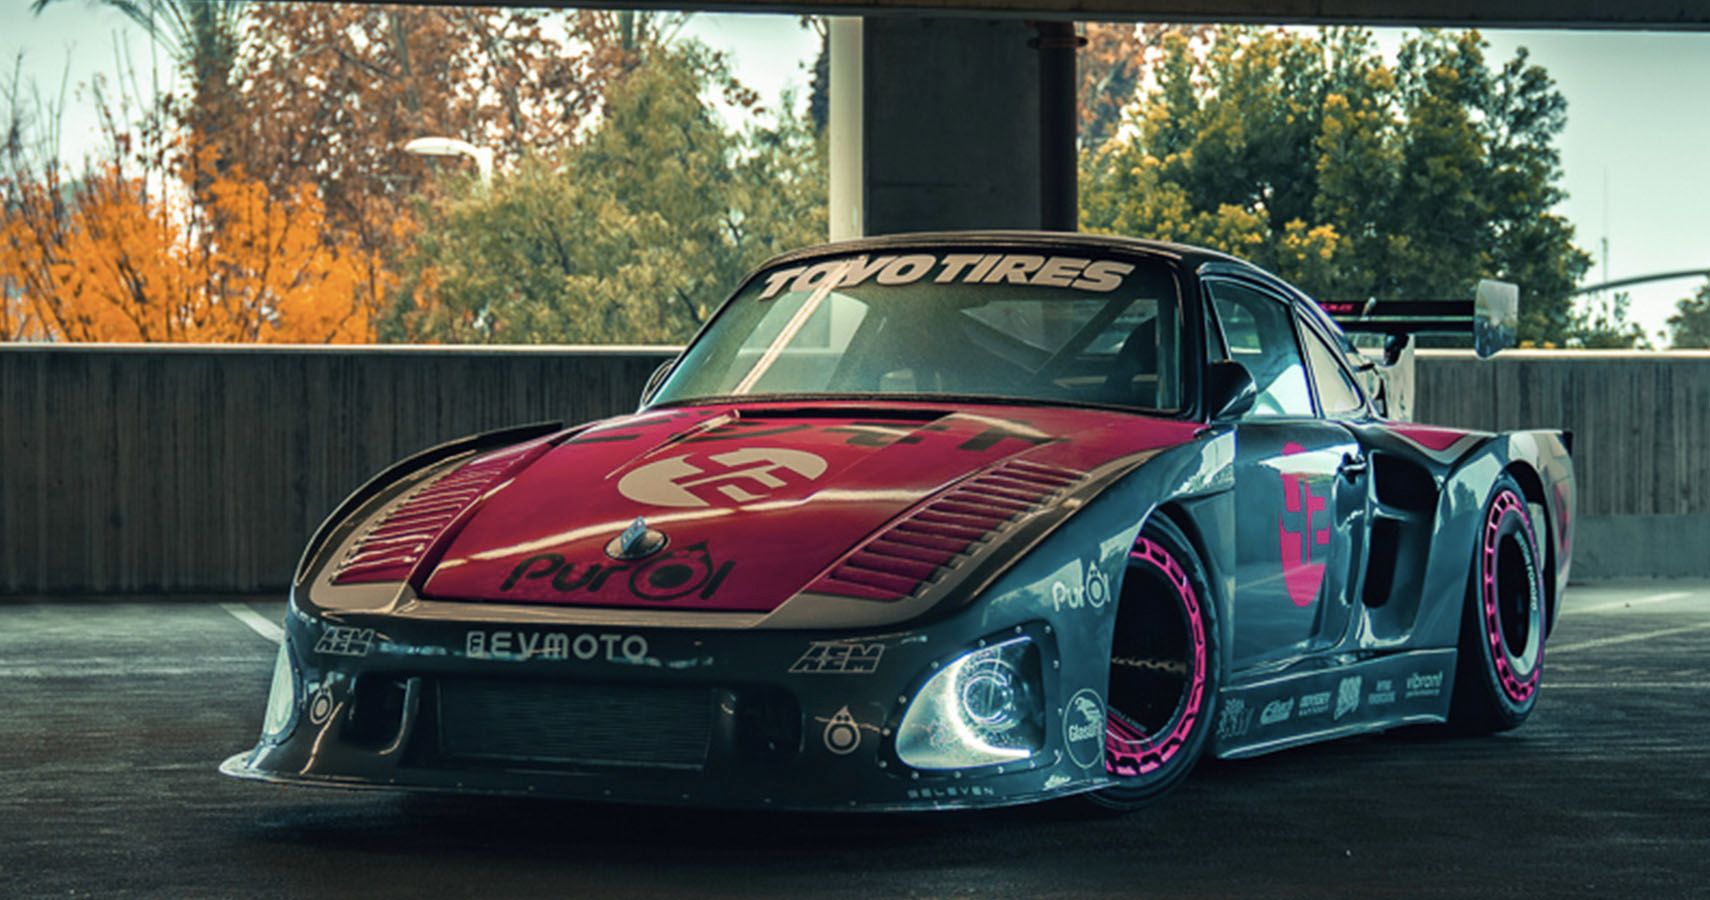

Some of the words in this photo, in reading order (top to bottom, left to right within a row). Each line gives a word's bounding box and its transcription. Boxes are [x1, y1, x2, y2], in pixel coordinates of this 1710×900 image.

[758, 254, 935, 300] TOYO
[934, 253, 1135, 292] TIRES
[788, 640, 885, 673] AEM
